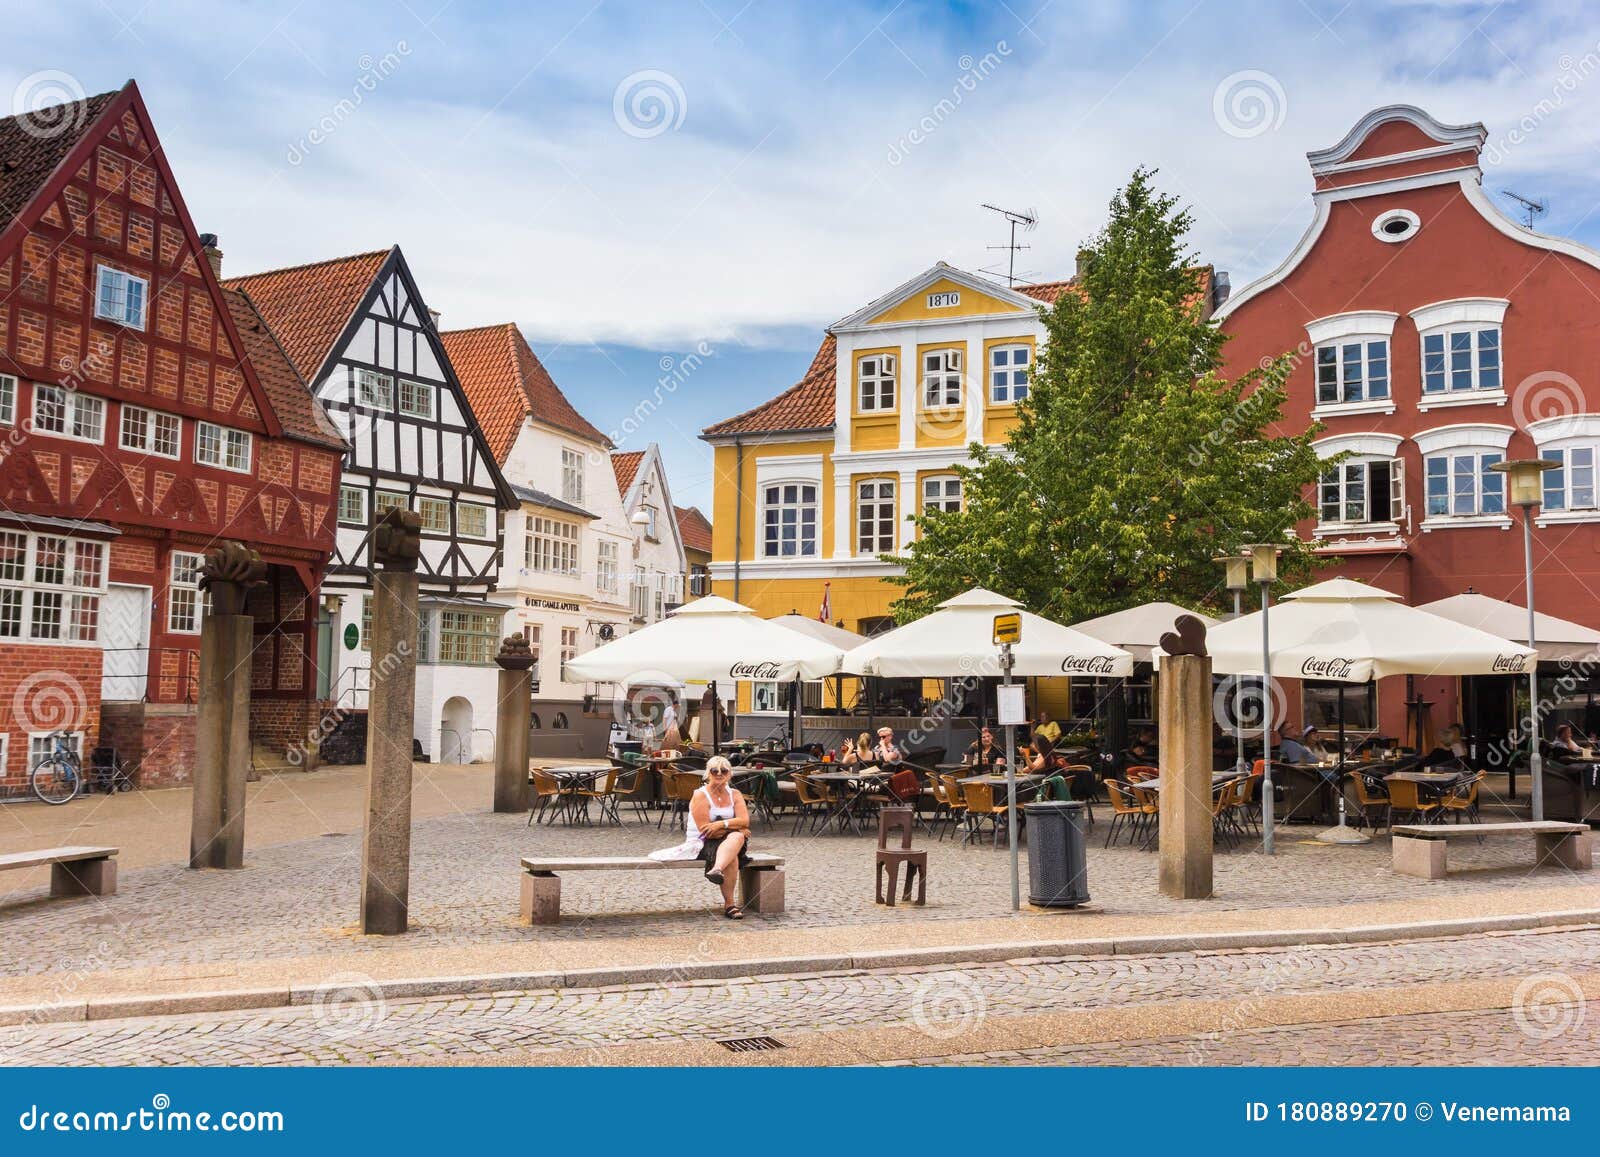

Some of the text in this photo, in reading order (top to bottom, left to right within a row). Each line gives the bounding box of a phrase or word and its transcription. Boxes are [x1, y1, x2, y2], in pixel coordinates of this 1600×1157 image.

[929, 293, 959, 307] 1870
[531, 598, 580, 612] DET GAMLE APOTEK
